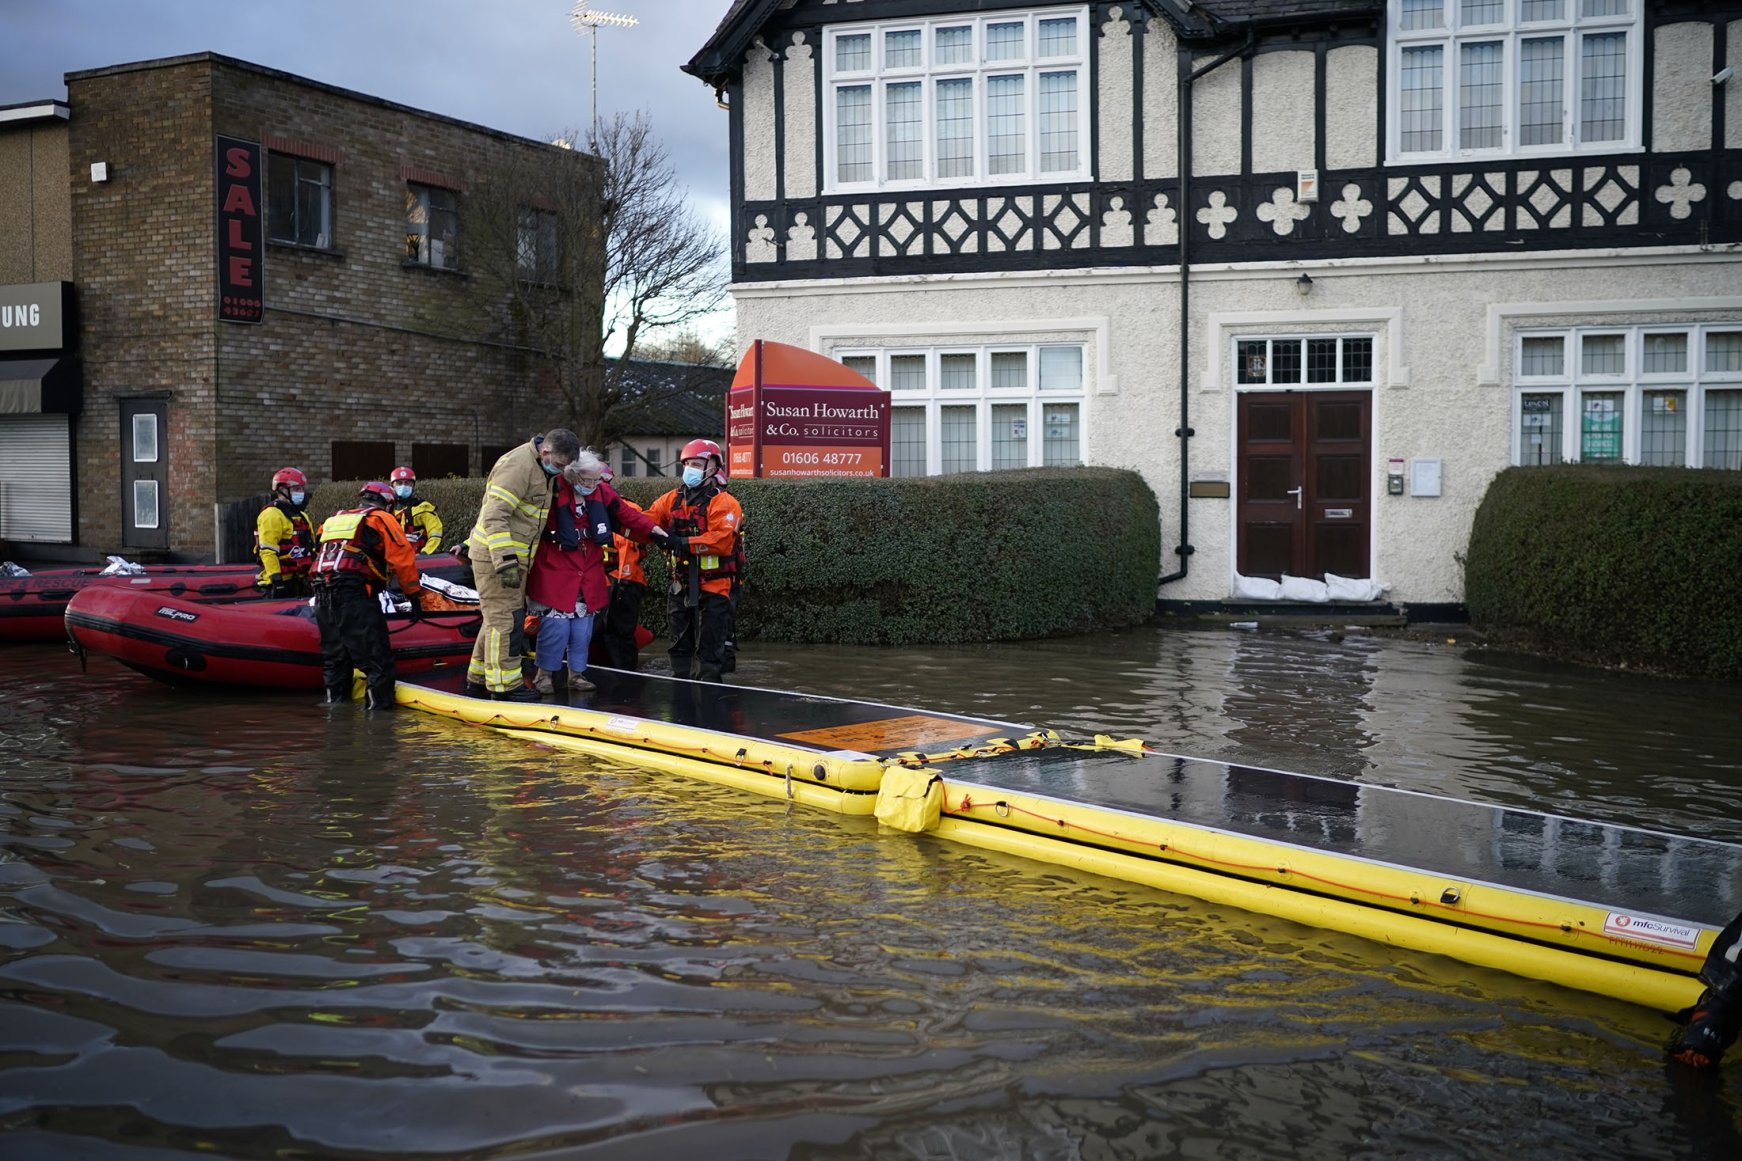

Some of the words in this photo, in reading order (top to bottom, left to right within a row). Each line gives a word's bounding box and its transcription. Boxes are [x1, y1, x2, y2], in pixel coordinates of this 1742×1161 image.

[222, 147, 256, 287] SALE
[2, 303, 40, 328] UNG
[766, 401, 810, 418] Susan
[813, 403, 879, 419] Howarth
[803, 425, 879, 437] solicitors
[782, 452, 819, 464] 01606
[822, 452, 862, 465] 48777
[769, 468, 874, 477] susanhowarthsolicitors.co.uk
[1632, 919, 1691, 937] mfcSurvival
